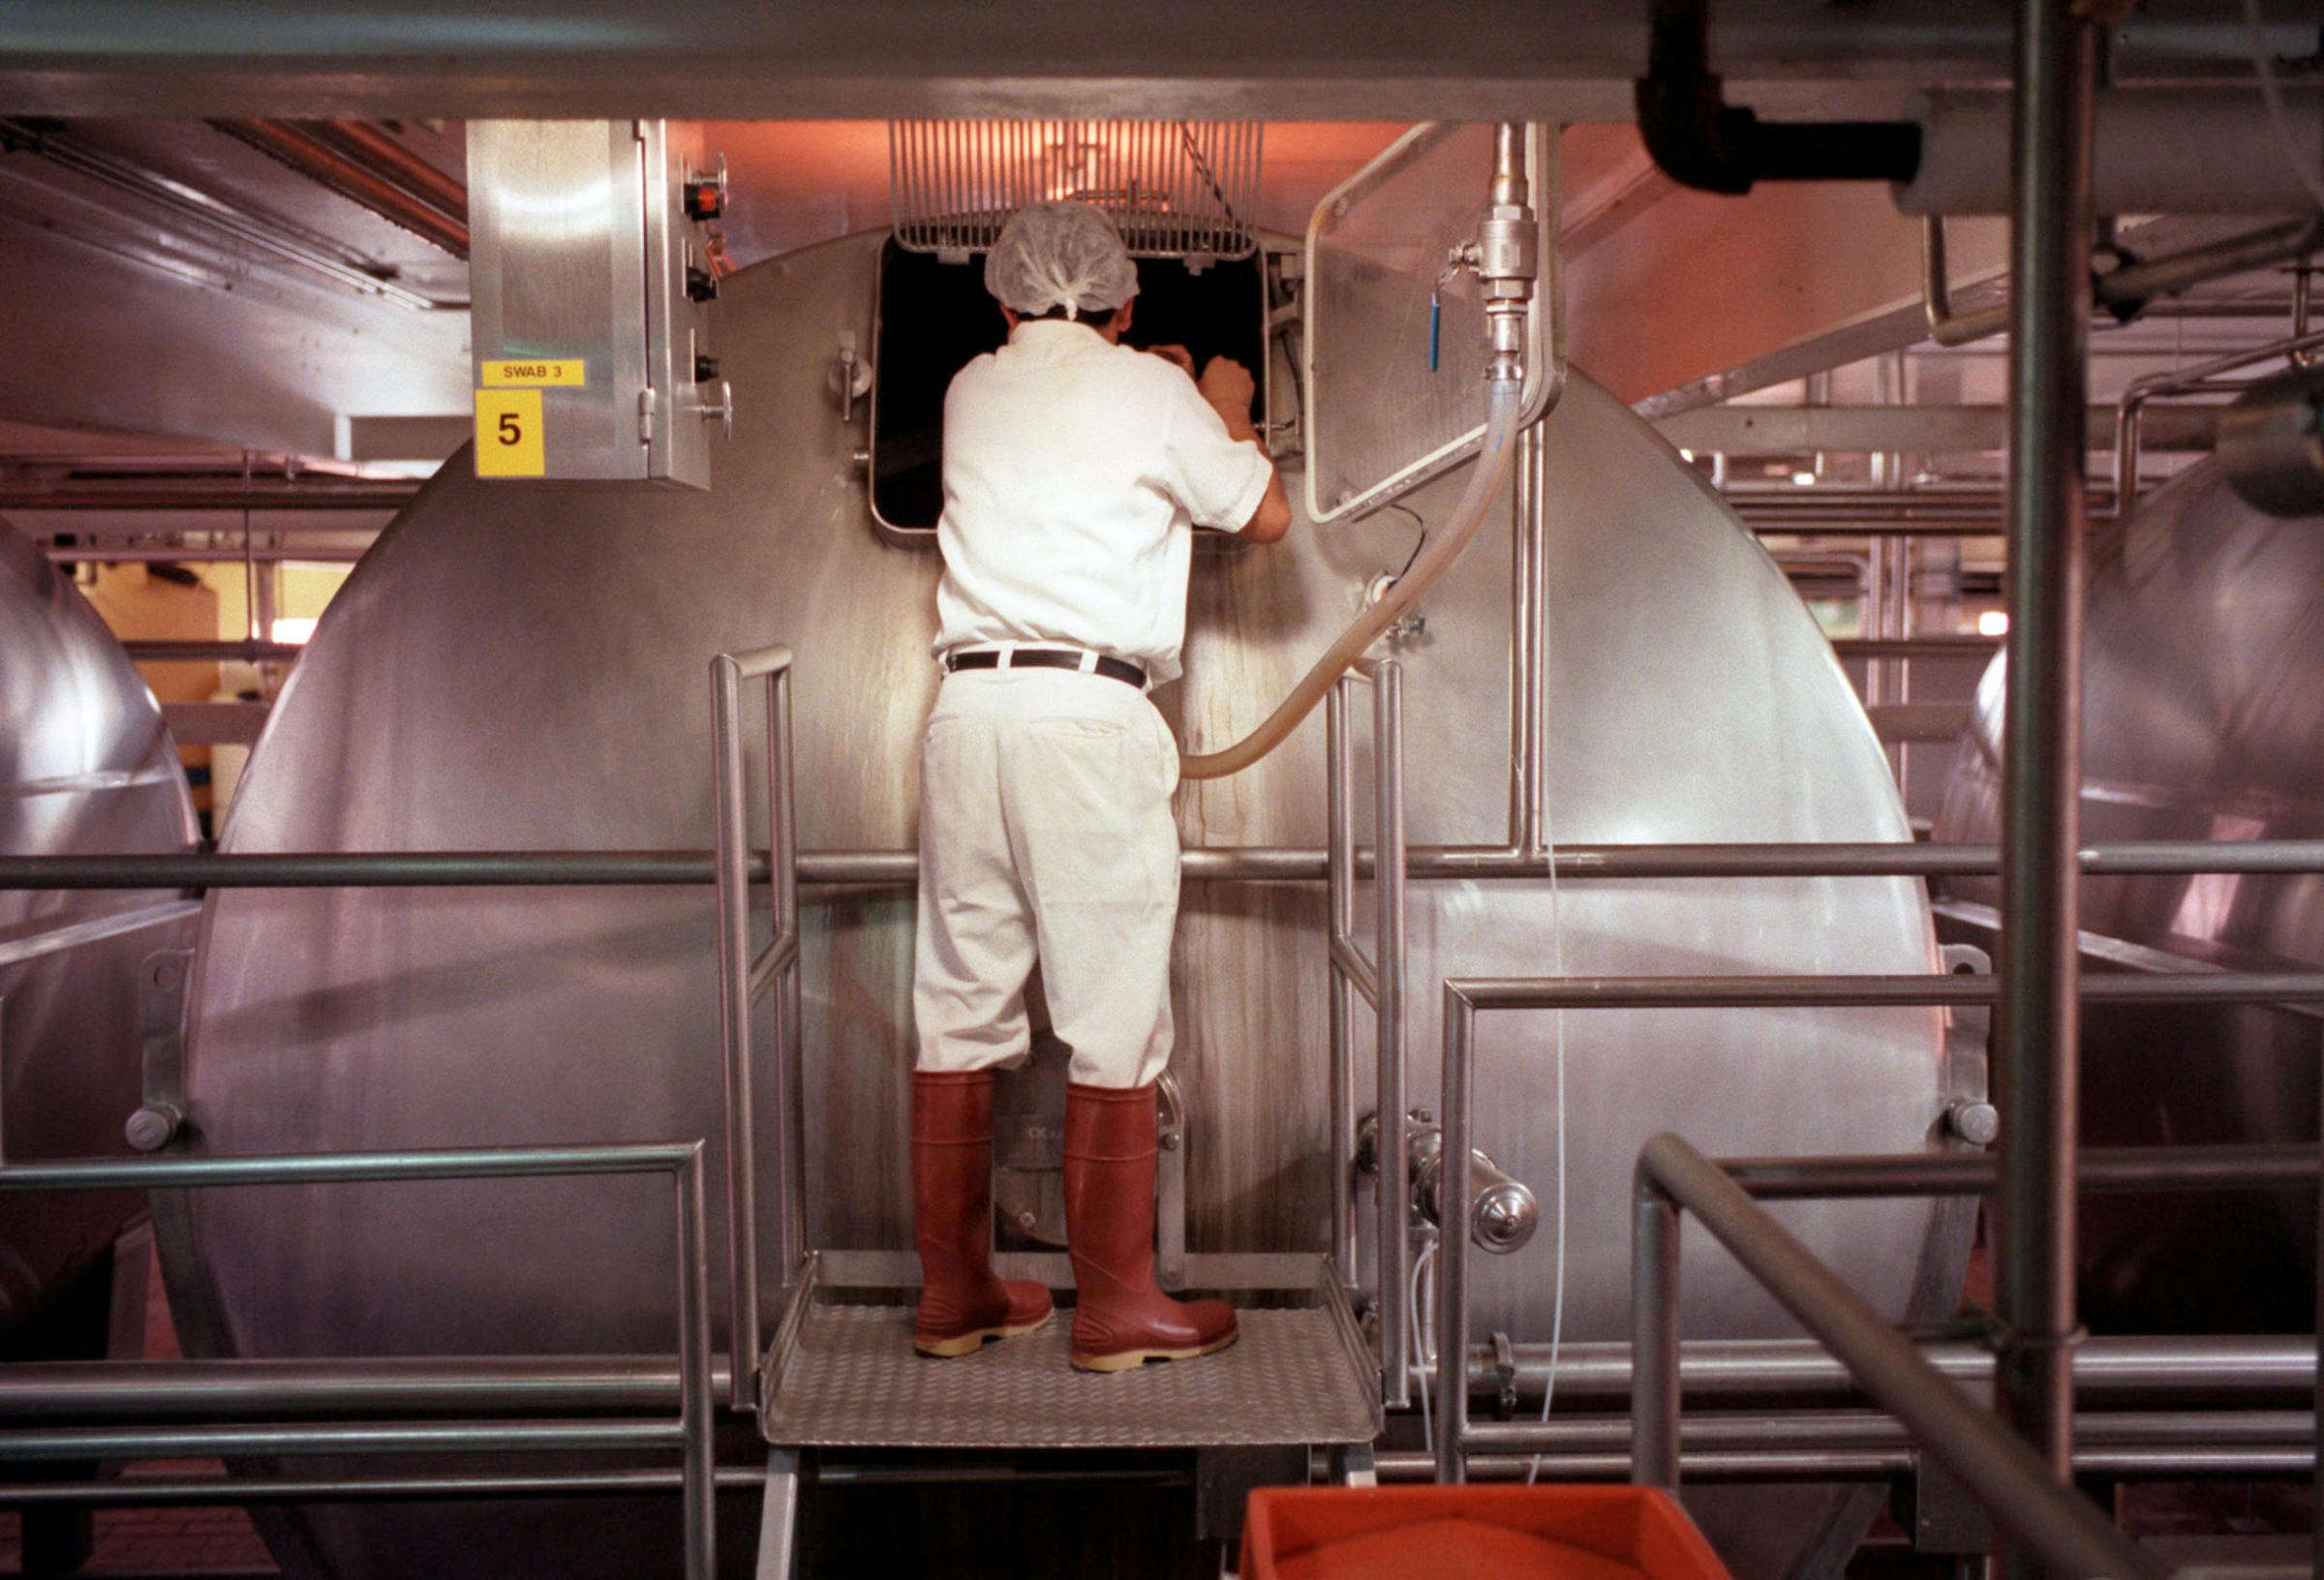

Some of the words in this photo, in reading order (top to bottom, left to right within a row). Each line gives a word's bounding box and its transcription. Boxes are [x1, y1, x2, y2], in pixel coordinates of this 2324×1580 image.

[504, 366, 547, 379] SWAB
[553, 365, 563, 378] 3
[498, 413, 521, 445] 5
